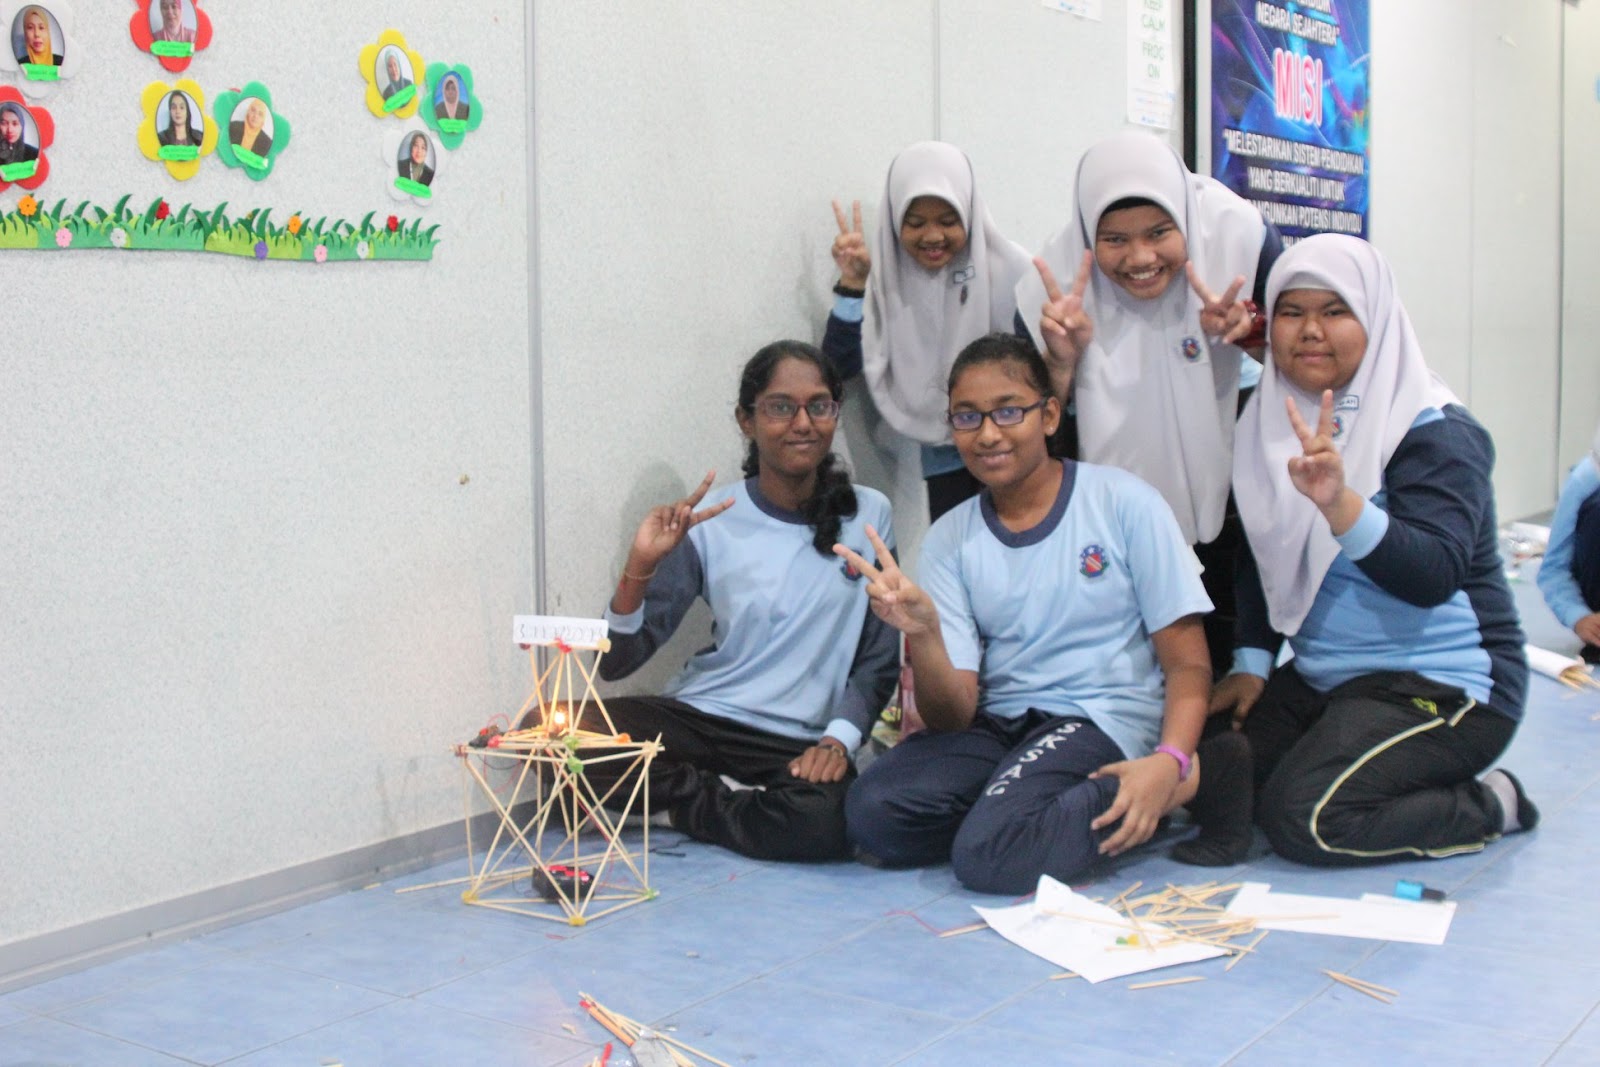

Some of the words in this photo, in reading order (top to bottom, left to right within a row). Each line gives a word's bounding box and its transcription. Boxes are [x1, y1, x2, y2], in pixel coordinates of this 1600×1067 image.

[1141, 14, 1165, 32] CALM
[1256, 1, 1290, 31] NEGARA
[1142, 42, 1165, 60] FROG
[1147, 64, 1160, 79] ON
[1274, 47, 1323, 126] MISI
[1294, 142, 1320, 166] SISTEM
[1321, 148, 1364, 175] PENDIDIKAN
[1248, 167, 1273, 190] YANG
[1275, 171, 1319, 196] BERKUALITI
[1320, 178, 1345, 201] UNTUK
[1299, 206, 1331, 229] POTENSI
[1332, 211, 1363, 234] INDIVIDU
